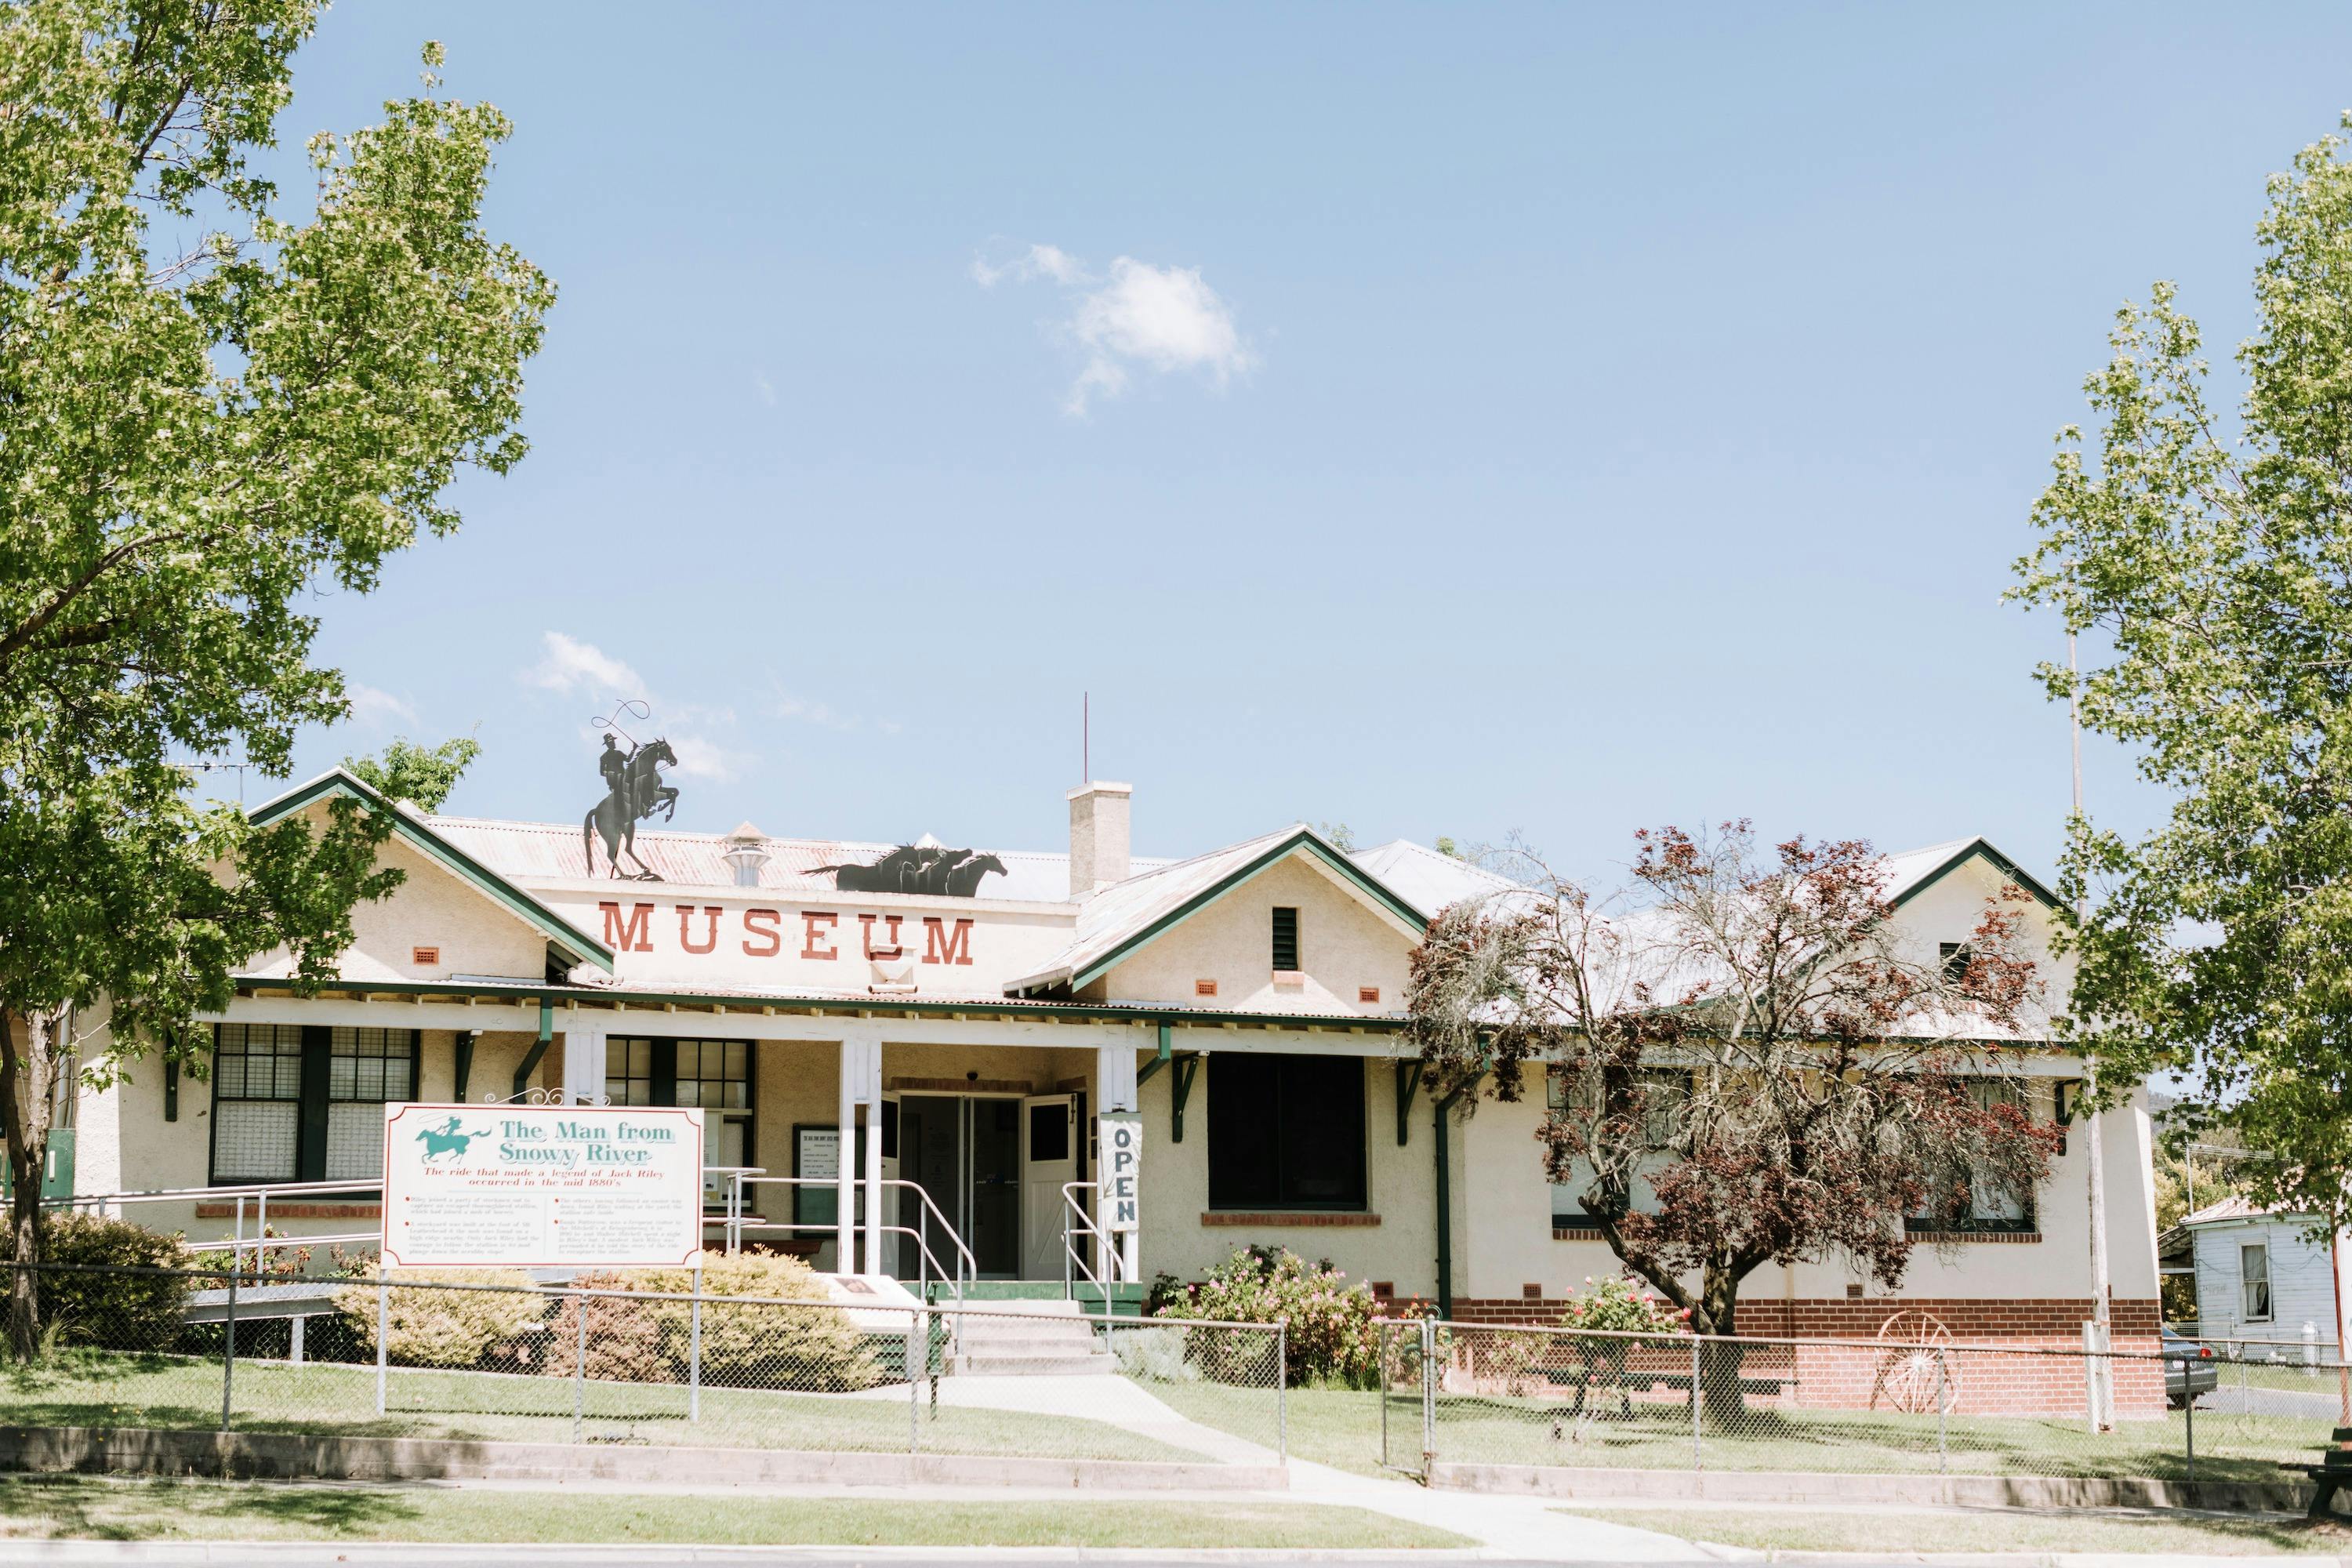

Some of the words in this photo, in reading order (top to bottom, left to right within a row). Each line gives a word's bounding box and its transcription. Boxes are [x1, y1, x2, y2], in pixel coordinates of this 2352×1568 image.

[599, 901, 974, 965] MUSEUM
[499, 1120, 543, 1138] The
[554, 1121, 606, 1139] Man
[617, 1122, 672, 1140] from
[499, 1142, 575, 1166] Snowy
[586, 1144, 648, 1162] River
[424, 1167, 445, 1176] The
[449, 1167, 471, 1176] ride
[477, 1168, 499, 1177] that
[504, 1167, 534, 1177] made
[552, 1169, 587, 1178] legend
[591, 1169, 603, 1178] of
[637, 1170, 665, 1180] Riley
[1114, 1128, 1135, 1222] OPEN
